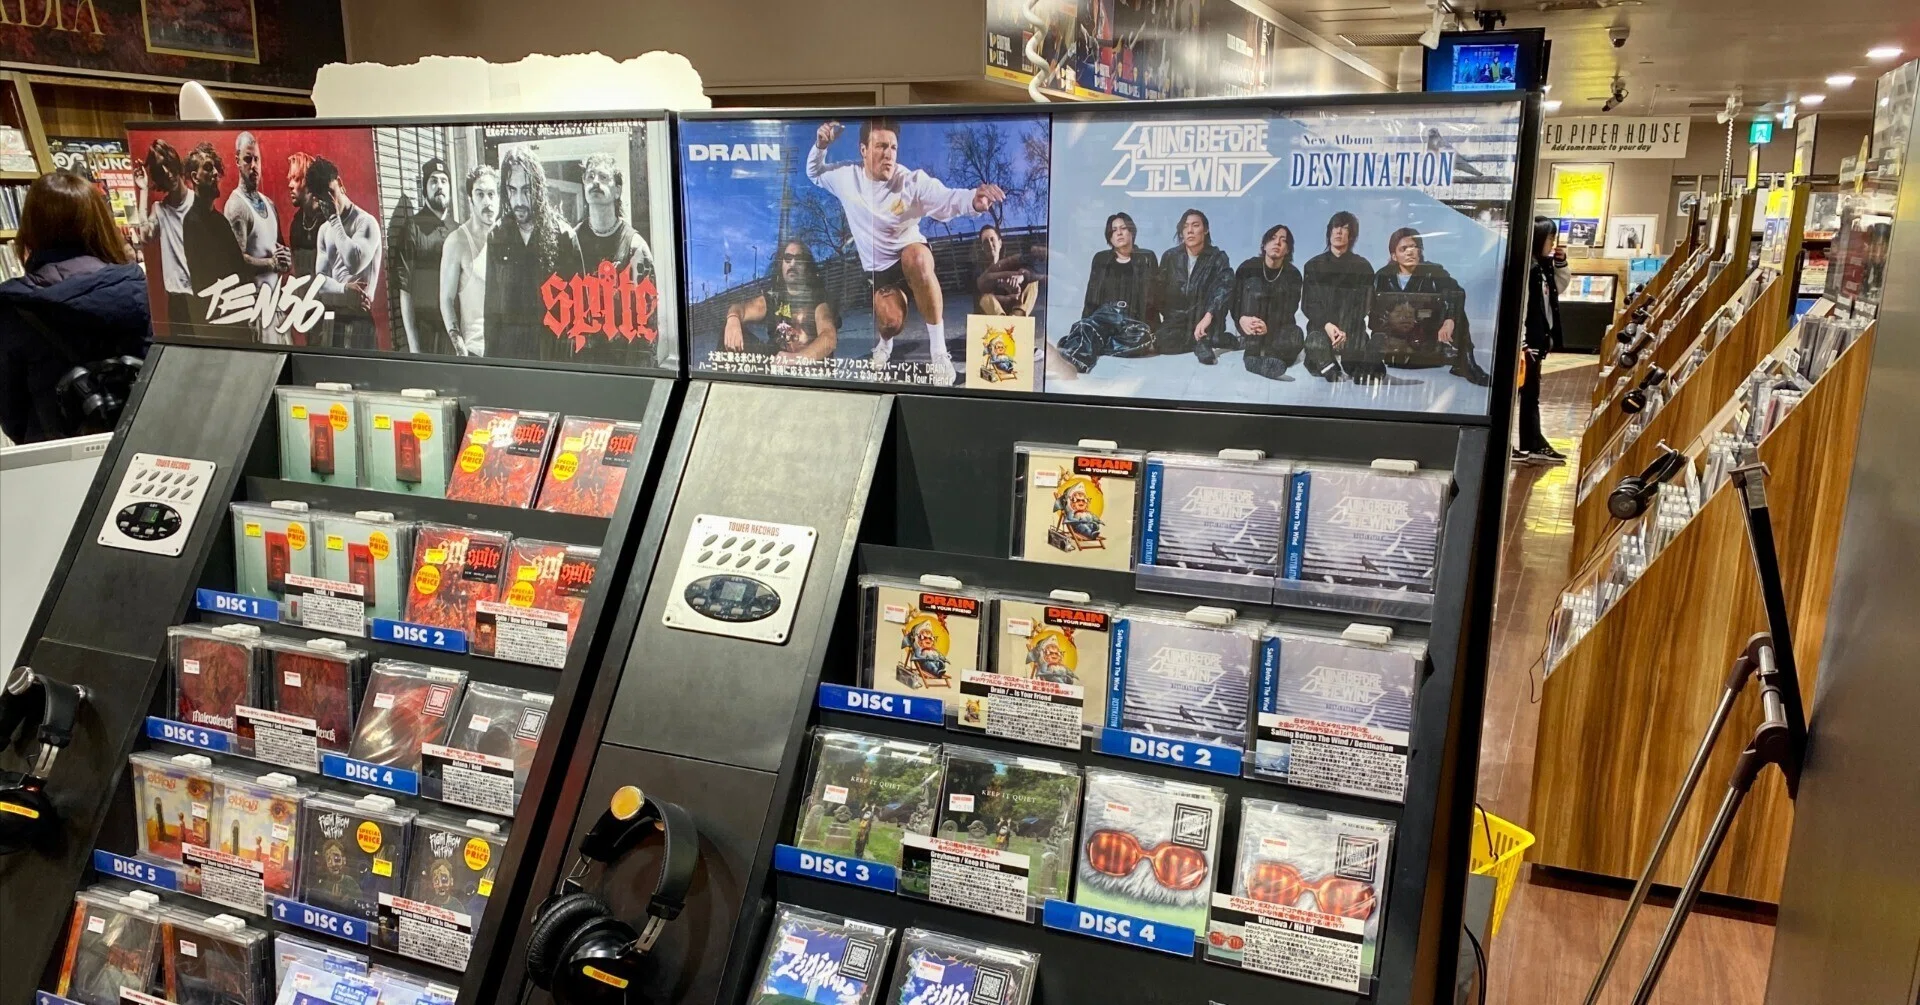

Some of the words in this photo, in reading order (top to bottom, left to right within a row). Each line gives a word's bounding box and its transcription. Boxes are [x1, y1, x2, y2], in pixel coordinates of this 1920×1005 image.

[1303, 134, 1328, 145] New
[1334, 134, 1374, 146] Album
[1545, 124, 1563, 144] ED
[1570, 123, 1619, 144] PIPER
[1626, 122, 1682, 143] HOUSE
[688, 143, 781, 162] DRAIN
[1551, 143, 1566, 151] Add
[1585, 143, 1607, 151] music
[1617, 144, 1637, 152] your
[1637, 143, 1652, 152] day
[99, 158, 132, 170] UNC
[1290, 151, 1456, 188] DESTINATION
[198, 273, 335, 335] TEN56.
[540, 260, 659, 354] spite
[412, 423, 432, 431] PRICE
[461, 455, 483, 465] PRICE
[554, 463, 577, 472] PRICE
[1077, 457, 1133, 470] DRAIN
[1149, 471, 1158, 490] Sailing
[1149, 490, 1157, 507] Before
[1294, 481, 1304, 501] Sailing
[1294, 501, 1302, 519] Before
[728, 521, 749, 533] TOWER
[750, 523, 780, 537] RECORDS
[1147, 519, 1155, 532] Wind
[1293, 520, 1301, 531] The
[288, 534, 306, 543] PRICE
[1291, 531, 1300, 546] Wind
[369, 542, 389, 553] PRICE
[417, 576, 439, 587] PRICE
[215, 594, 248, 612] DISC
[251, 601, 259, 614] 1
[511, 593, 534, 602] PRICE
[922, 594, 975, 609] DRAIN
[936, 605, 951, 613] YOUR
[1048, 608, 1105, 622] DRAIN
[1063, 619, 1079, 627] YOUR
[1080, 621, 1101, 629] FRIEND
[392, 624, 428, 643] DISC
[433, 631, 445, 645] 2
[1115, 629, 1124, 648] Sailing
[1114, 648, 1123, 666] Before
[1264, 647, 1274, 667] Sailing
[1113, 677, 1121, 691] Wind
[1264, 667, 1273, 686] Before
[990, 686, 1005, 694] Drain
[1020, 691, 1033, 699] Your
[1033, 692, 1052, 701] Friend
[1263, 686, 1271, 696] The
[847, 690, 894, 711] DISC
[901, 697, 911, 715] 1
[1262, 697, 1271, 711] Wind
[163, 724, 196, 743] DISC
[199, 731, 210, 746] 3
[1271, 728, 1294, 738] Sailing
[1294, 731, 1317, 742] Before
[1317, 733, 1331, 744] The
[1331, 735, 1349, 746] Wind
[1353, 740, 1394, 752] Destination
[1129, 737, 1184, 761] DISC
[1195, 747, 1212, 766] 2
[345, 762, 378, 782] DISC
[382, 771, 394, 785] 4
[850, 776, 868, 784] KEEP
[879, 780, 902, 791] QUIET
[980, 788, 1000, 797] KEEP
[1012, 793, 1037, 804] QUIET
[358, 826, 380, 837] SPECIAL
[358, 833, 382, 845] PRICE
[466, 849, 489, 862] PRICE
[467, 843, 489, 854] SPECIAL
[113, 858, 143, 878] DISC
[147, 868, 156, 881] 5
[800, 853, 847, 877] DISC
[855, 864, 870, 881] 3
[303, 909, 338, 932] DISC
[342, 920, 354, 936] 6
[1079, 911, 1133, 938] DISC
[1140, 921, 1156, 943] 4
[1257, 915, 1288, 929] Vianova
